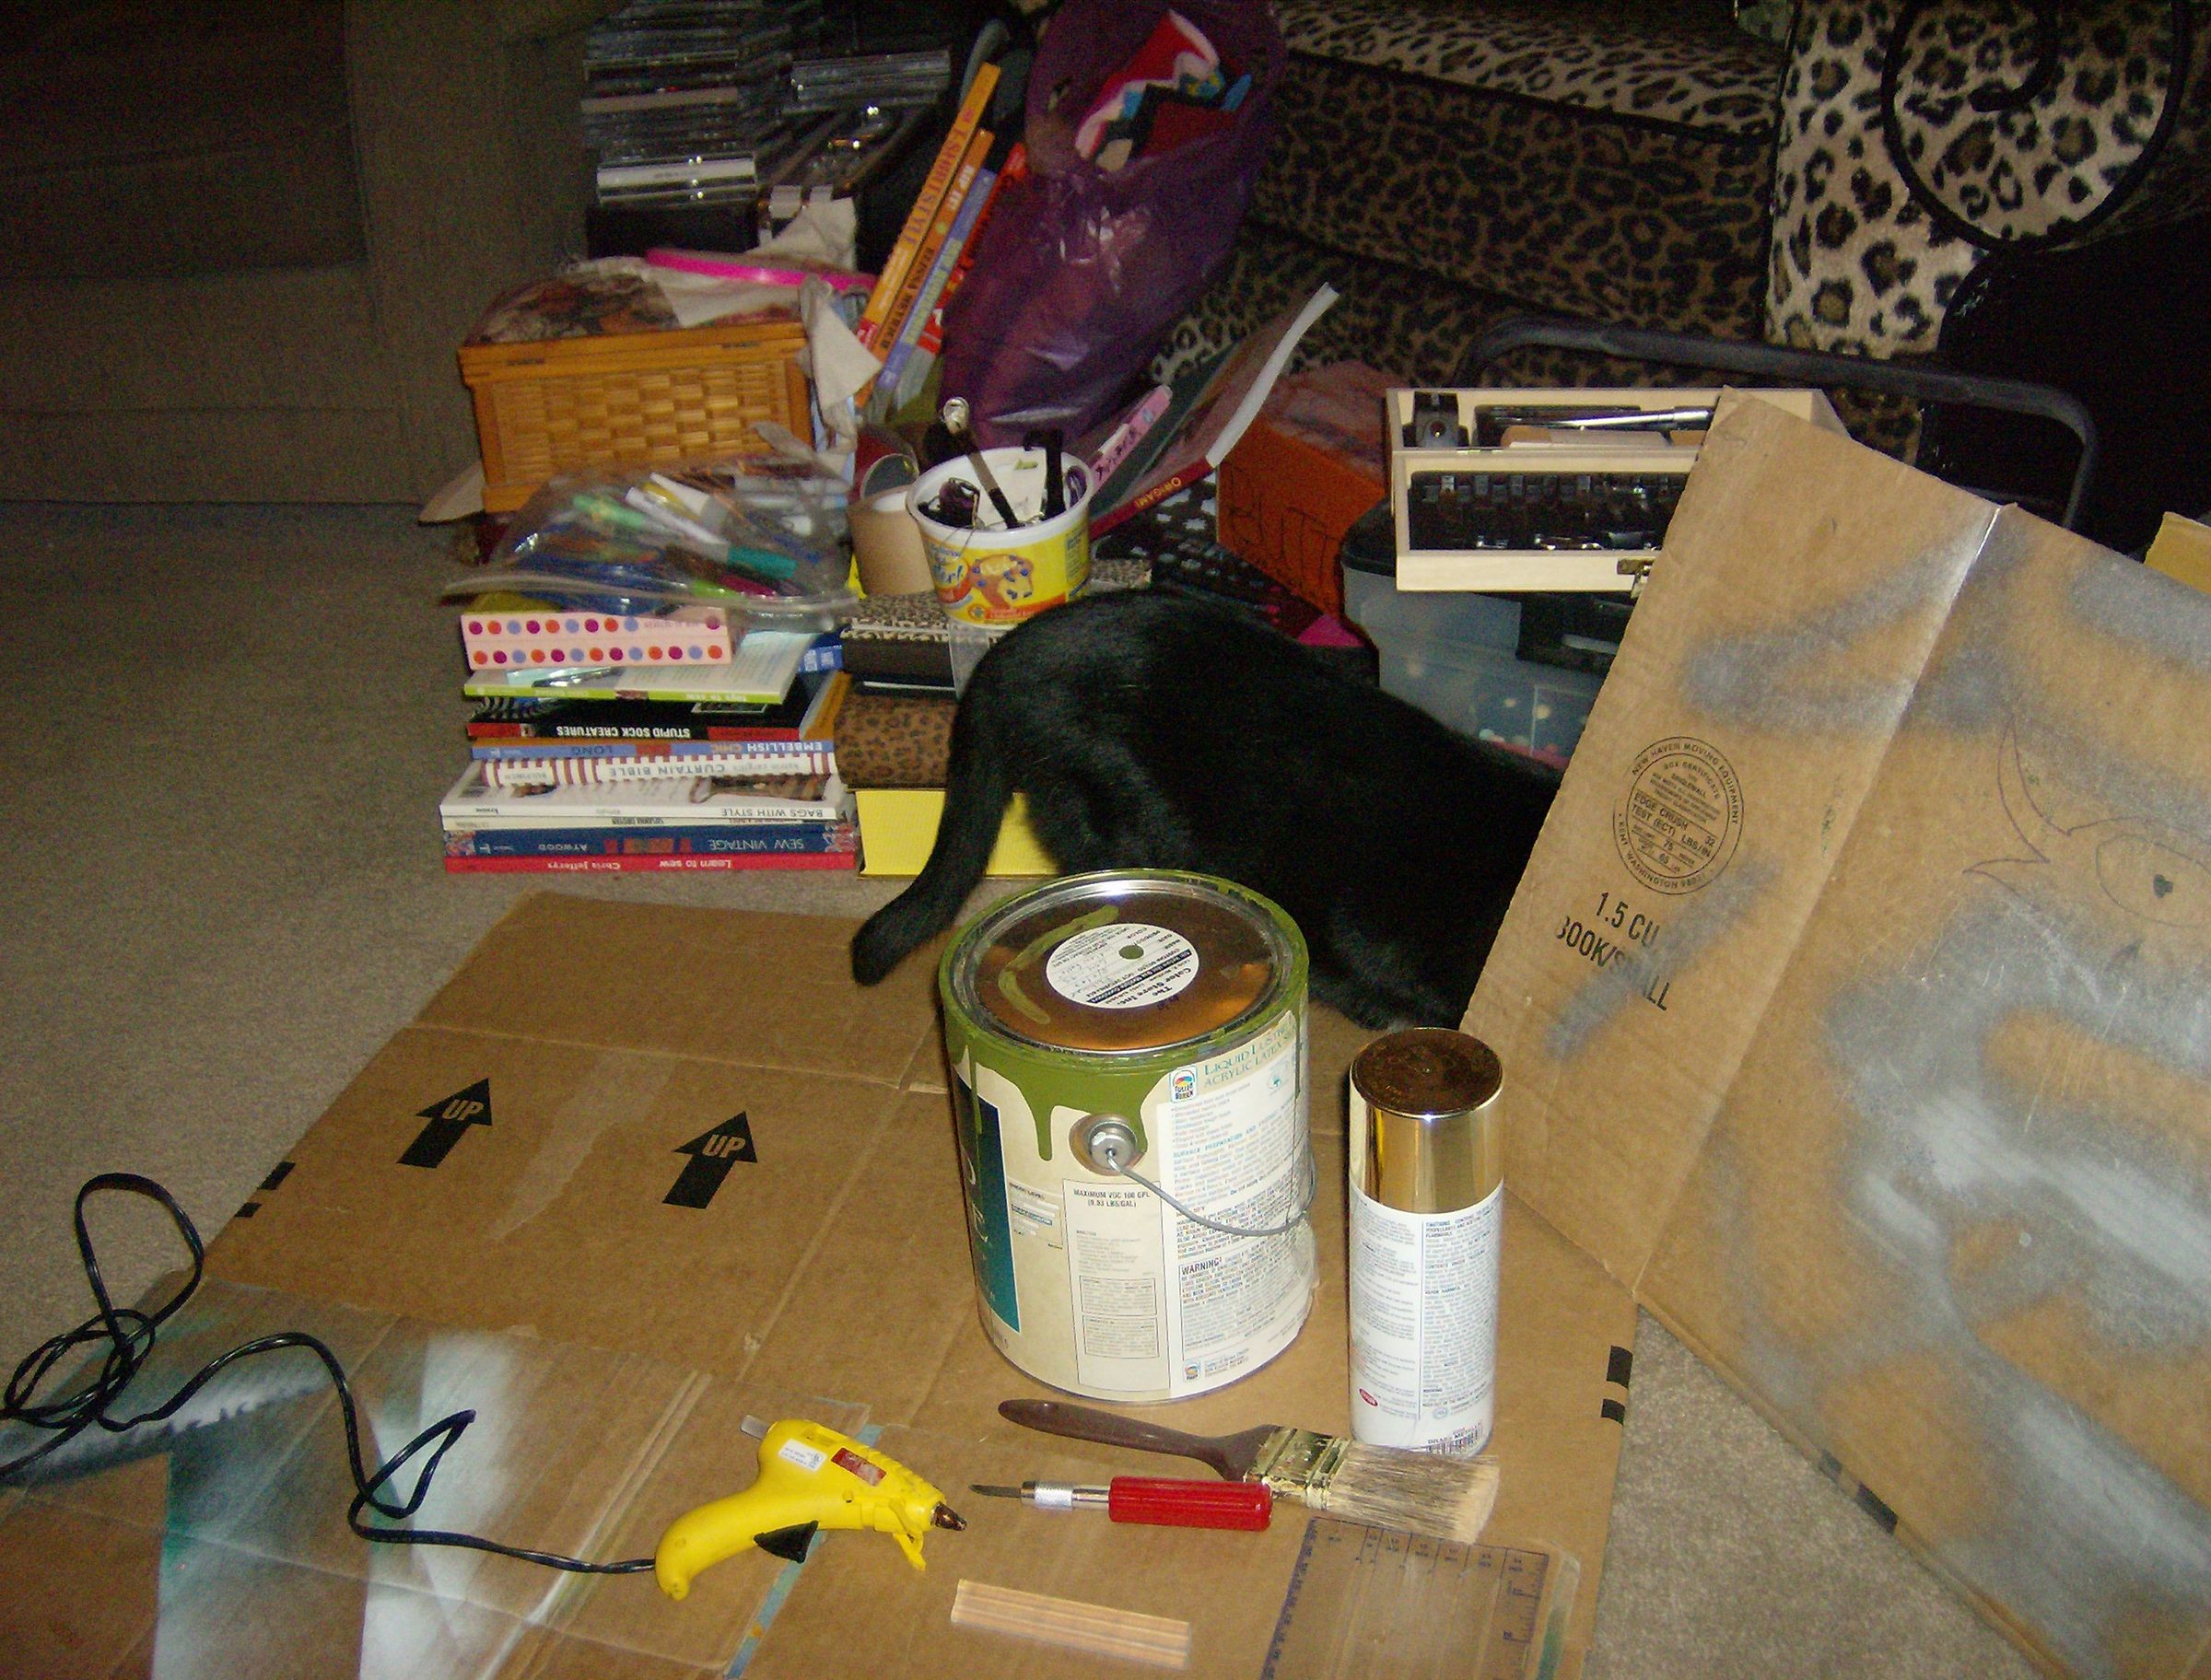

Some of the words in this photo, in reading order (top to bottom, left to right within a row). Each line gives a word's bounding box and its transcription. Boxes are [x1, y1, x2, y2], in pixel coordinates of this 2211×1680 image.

[1133, 477, 1183, 508] ORIGAMI
[556, 724, 618, 738] CREATURES
[620, 725, 651, 738] SOCK
[652, 727, 691, 739] STUPID
[570, 745, 614, 755] LONG
[710, 742, 743, 753] CHIC
[747, 741, 824, 752] EMBELLISH
[608, 766, 652, 777] BIBLE
[657, 763, 726, 775] CURTAIN
[1631, 757, 1650, 776] NEW
[1651, 742, 1682, 758] HAVEN
[1683, 743, 1719, 766] MOVING
[1719, 764, 1739, 826] EQUIPMENT
[720, 807, 754, 818] STYLE
[756, 808, 788, 818] WITH
[790, 809, 824, 818] BAGS
[1632, 803, 1653, 822] TEST
[1633, 791, 1657, 811] EDGE
[1659, 808, 1689, 831] CRUSH
[537, 842, 589, 852] ATWOOD
[708, 838, 767, 852] VINTAGE
[773, 838, 806, 852] SEW
[591, 861, 622, 870] Chris
[659, 860, 683, 869] sew
[684, 859, 699, 869] to
[699, 858, 732, 869] Learn
[1626, 850, 1679, 889] WASHINGTON
[1596, 892, 1629, 928] 1.5
[1628, 913, 1660, 949] CU
[1165, 966, 1193, 985] Color
[1136, 980, 1165, 998] Store
[1152, 985, 1174, 998] The
[1204, 1050, 1250, 1076] LIQUID
[1205, 1059, 1253, 1087] ACRYLIC
[442, 1099, 485, 1122] UP
[701, 1134, 748, 1159] UP
[1073, 1188, 1107, 1199] MAXIMUM
[1108, 1190, 1122, 1199] VOC
[1181, 1255, 1222, 1276] WARNING!
